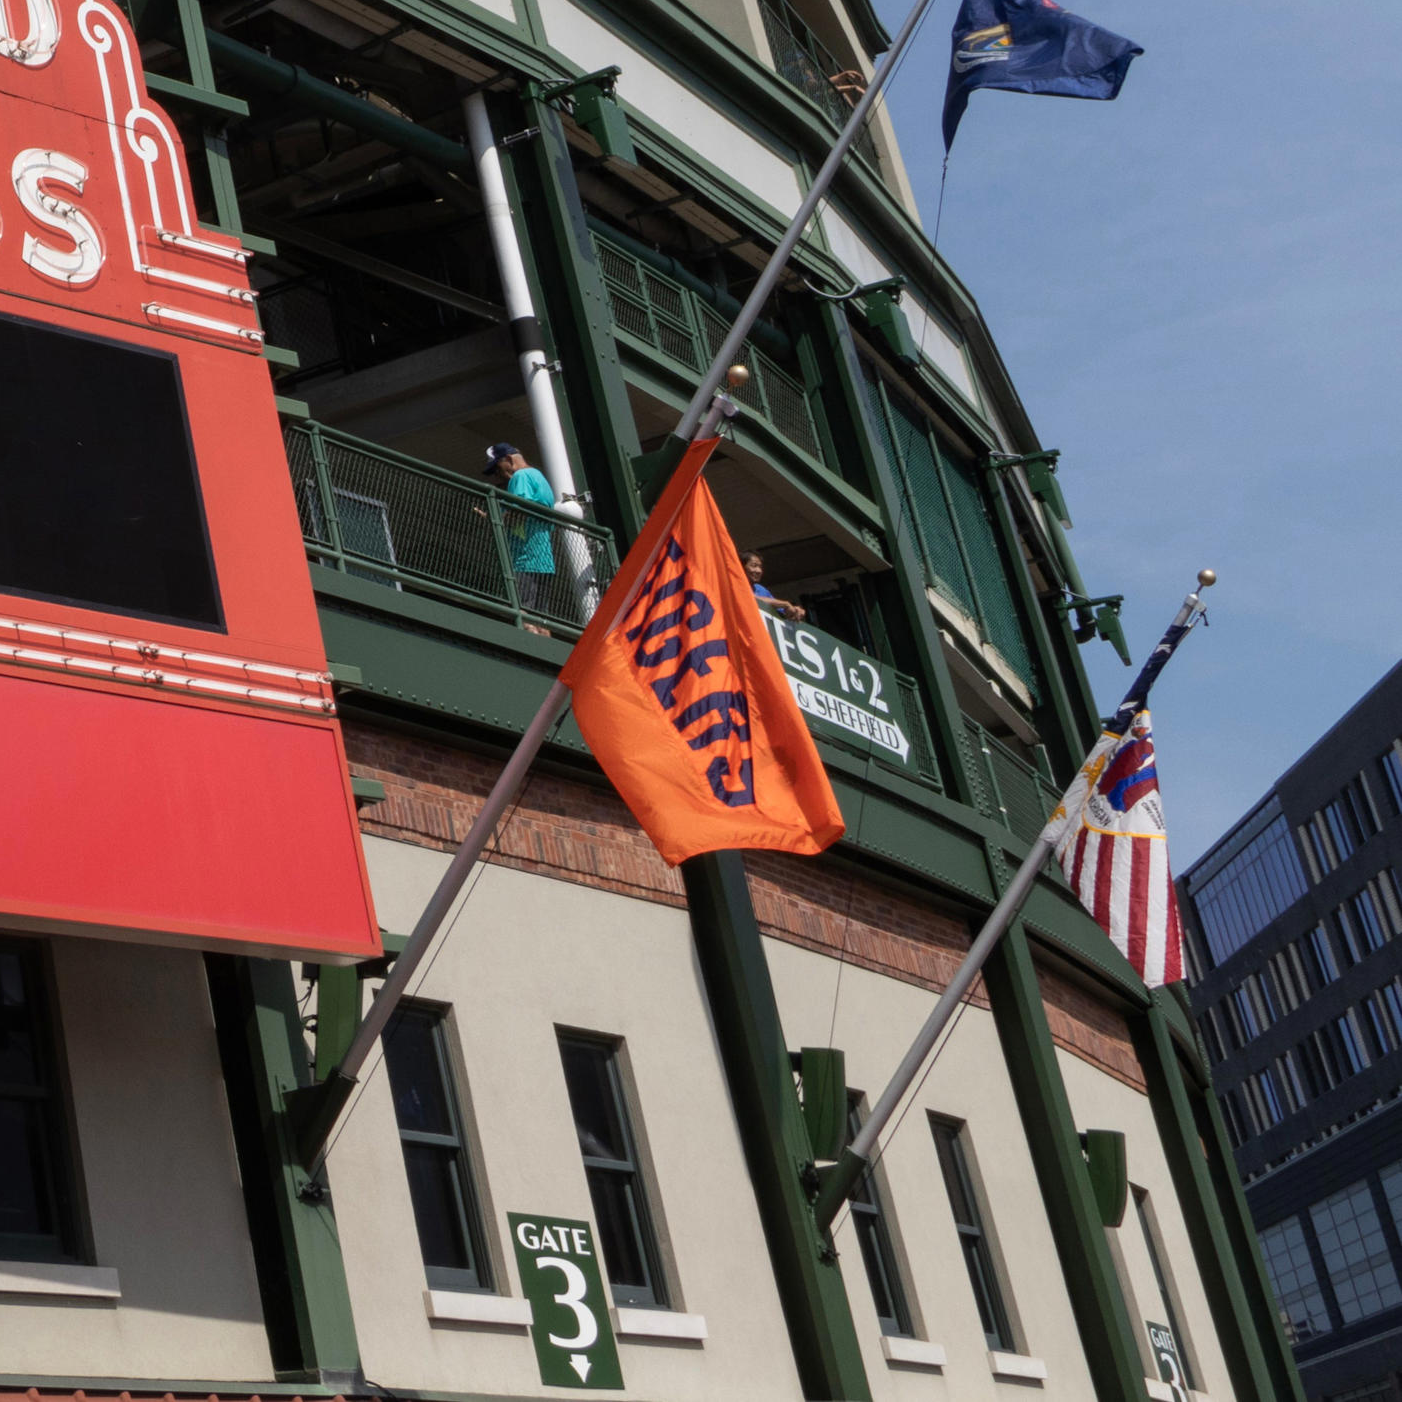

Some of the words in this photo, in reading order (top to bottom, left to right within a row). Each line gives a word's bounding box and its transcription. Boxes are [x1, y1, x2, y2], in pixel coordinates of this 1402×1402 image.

[814, 691, 899, 749] SHEFFIELD
[516, 1222, 591, 1256] GATE
[536, 1257, 598, 1348] 3
[1150, 1327, 1174, 1352] GATE
